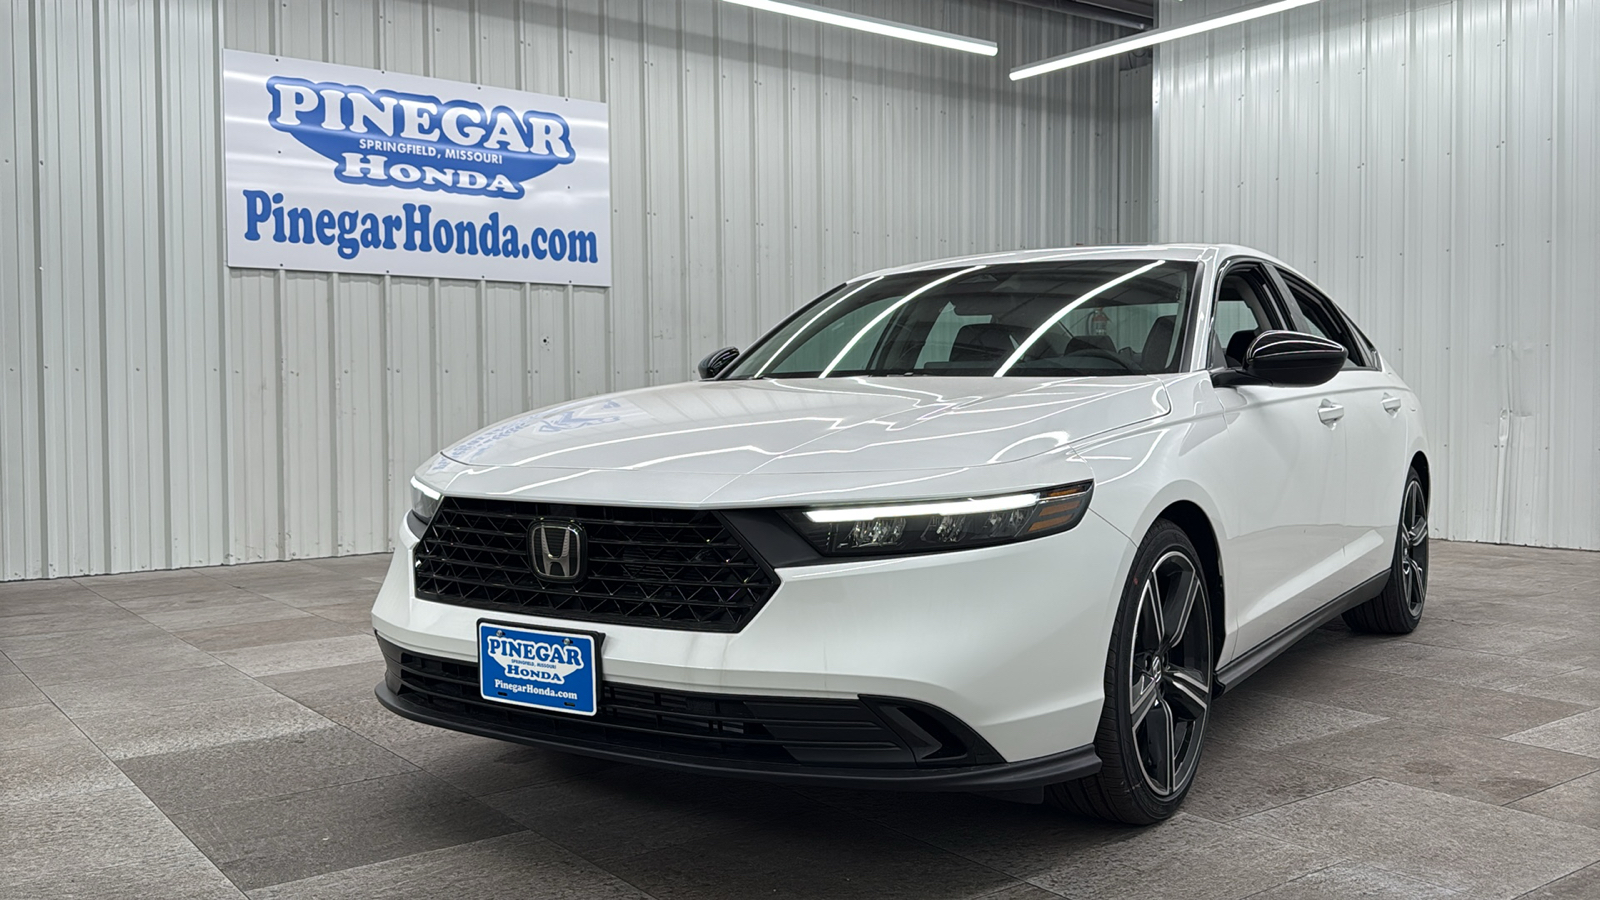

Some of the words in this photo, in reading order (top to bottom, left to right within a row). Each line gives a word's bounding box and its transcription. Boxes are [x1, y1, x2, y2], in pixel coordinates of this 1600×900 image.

[274, 83, 570, 158] PINEGAR
[359, 138, 441, 158] SPRINGFIELD,
[445, 149, 503, 164] MISSOURI
[341, 152, 519, 193] HONDA
[242, 189, 598, 263] PinegarHonda.com
[489, 638, 581, 666] PINEGAR
[506, 664, 563, 681] HONDA
[494, 679, 578, 700] PinegarHonda.com
